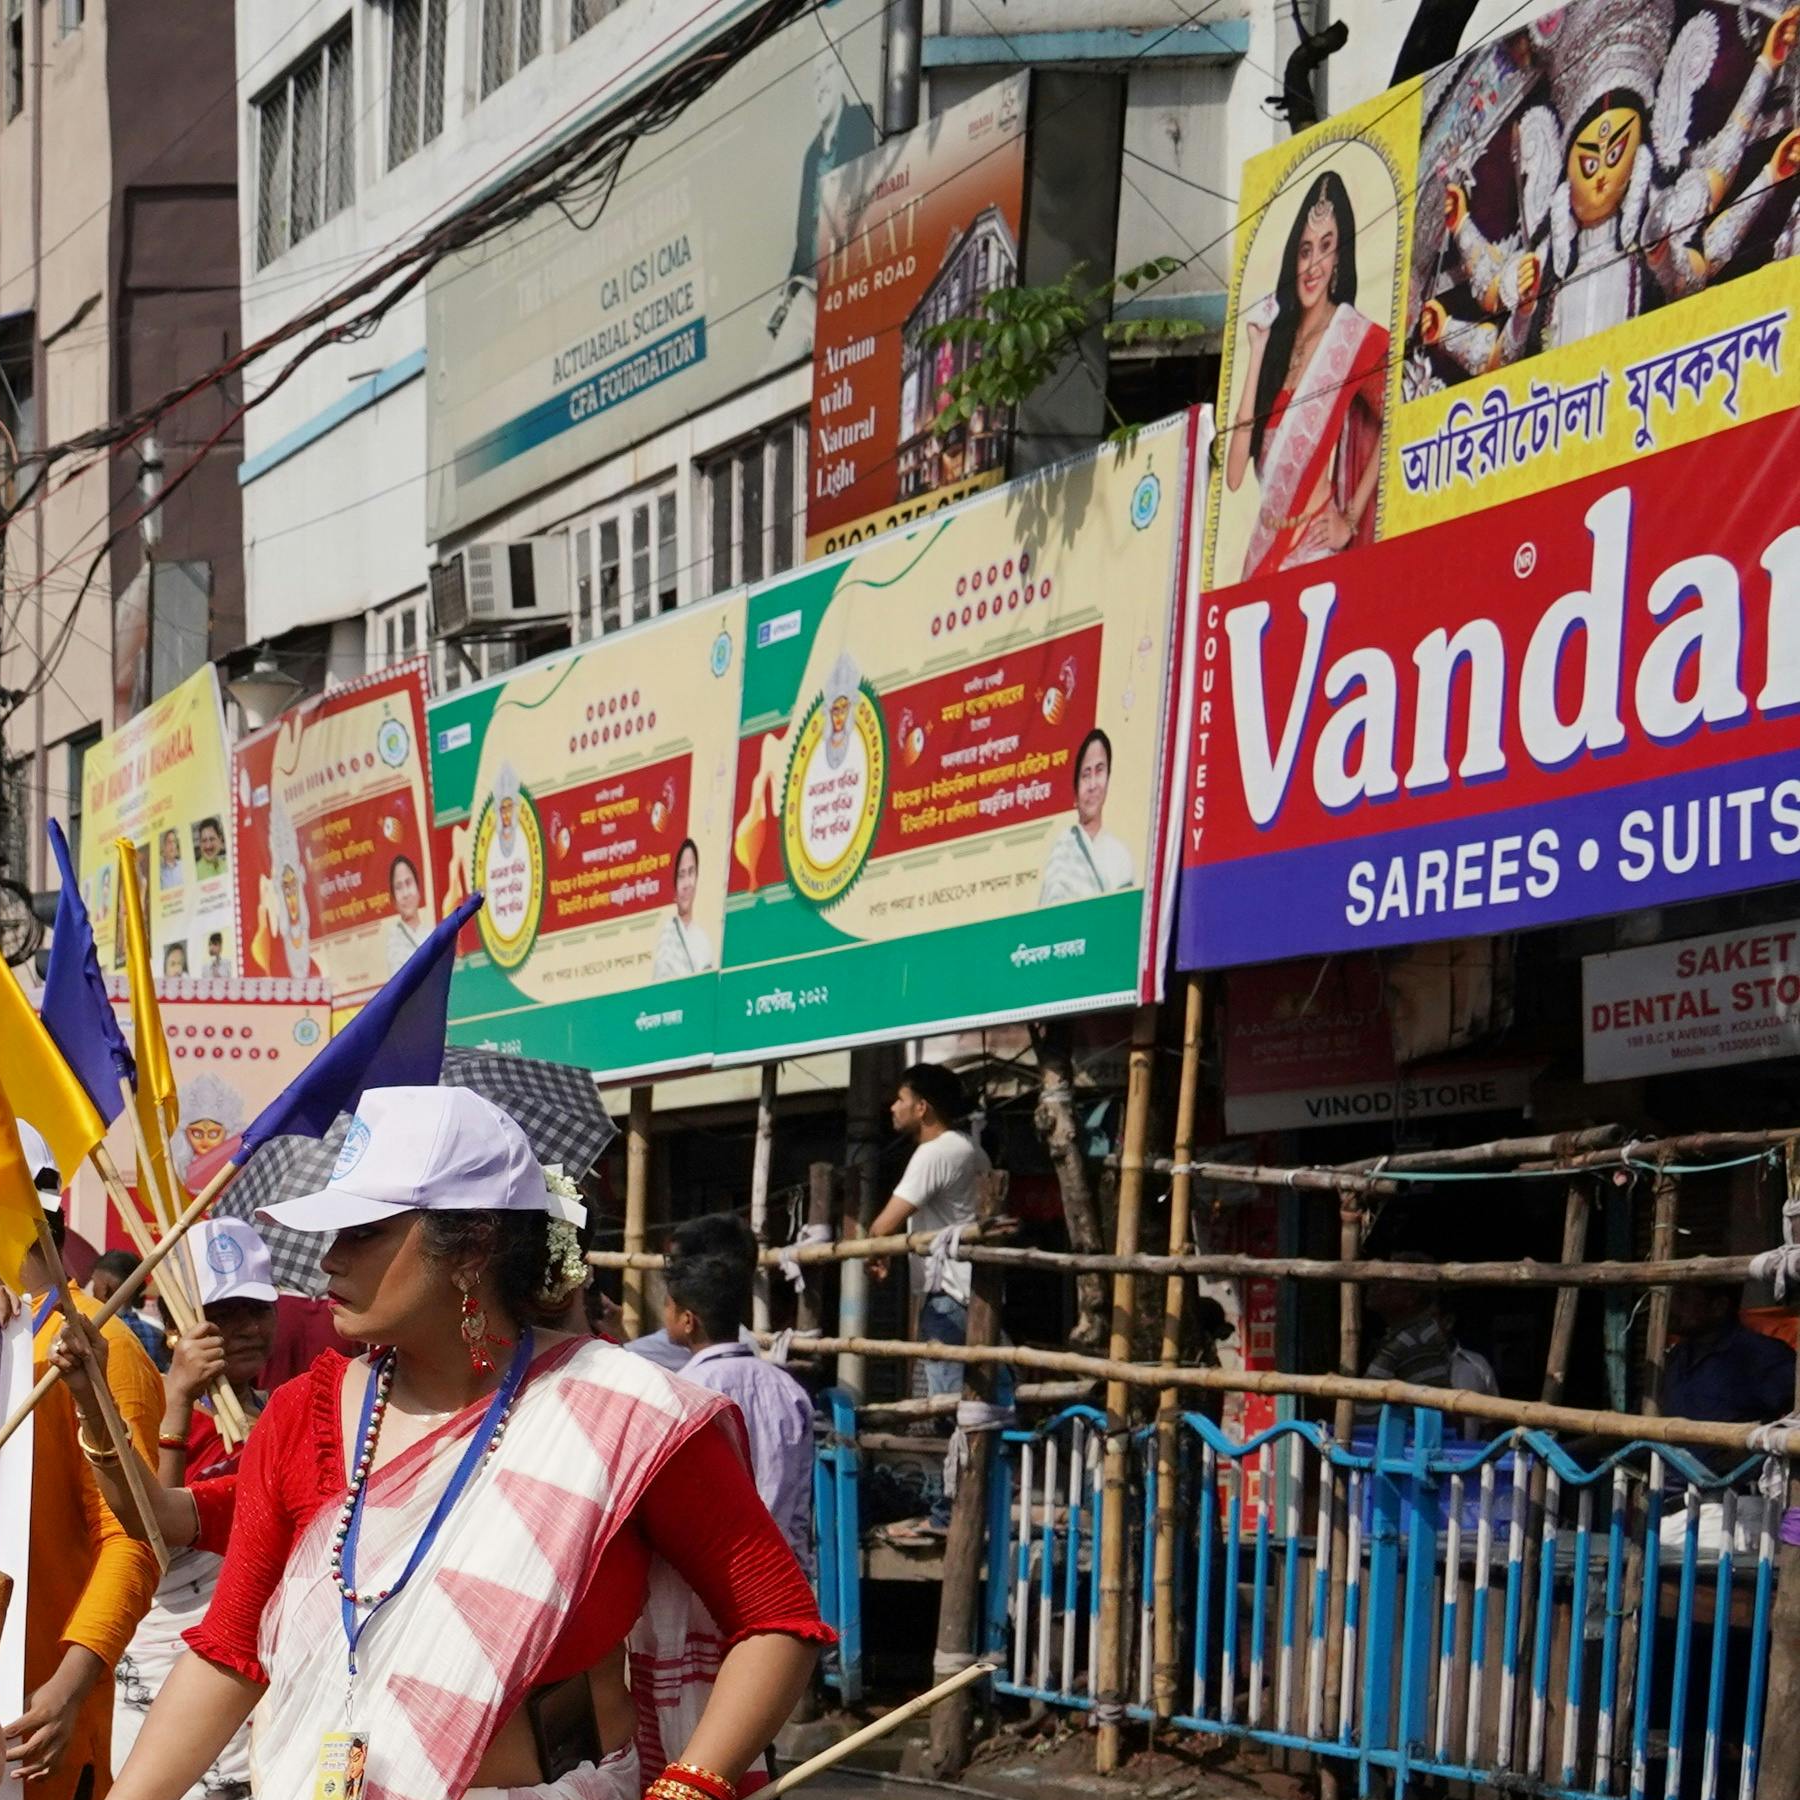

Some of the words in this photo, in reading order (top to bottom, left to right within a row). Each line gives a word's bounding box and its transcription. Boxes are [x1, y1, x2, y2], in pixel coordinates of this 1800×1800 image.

[601, 277, 621, 311] CA
[629, 259, 648, 295] CS
[657, 234, 693, 278] CMA
[824, 290, 843, 312] 40
[847, 276, 869, 304] MG
[874, 255, 917, 291] ROAD
[552, 319, 632, 387] ACTUARIAL
[632, 281, 695, 341] SCIENCE
[821, 335, 876, 378] Atrium
[568, 382, 601, 422] CFA
[599, 328, 697, 407] FOUNDATION
[820, 377, 853, 416] with
[1400, 371, 1610, 492] আহিরীটোলা
[1625, 311, 1788, 449] যুবকবৃন্দ
[818, 405, 876, 458] Natural
[816, 458, 856, 499] Light
[1191, 603, 1219, 853] COURTESY
[1344, 828, 1560, 928] SAREES
[1617, 779, 1800, 883] SUITS
[1676, 931, 1797, 980] SAKET
[798, 985, 830, 1006] ২০২২
[1591, 988, 1721, 1034] DENTAL
[1305, 1090, 1393, 1119] VINOD
[1401, 1081, 1498, 1111] STORE
